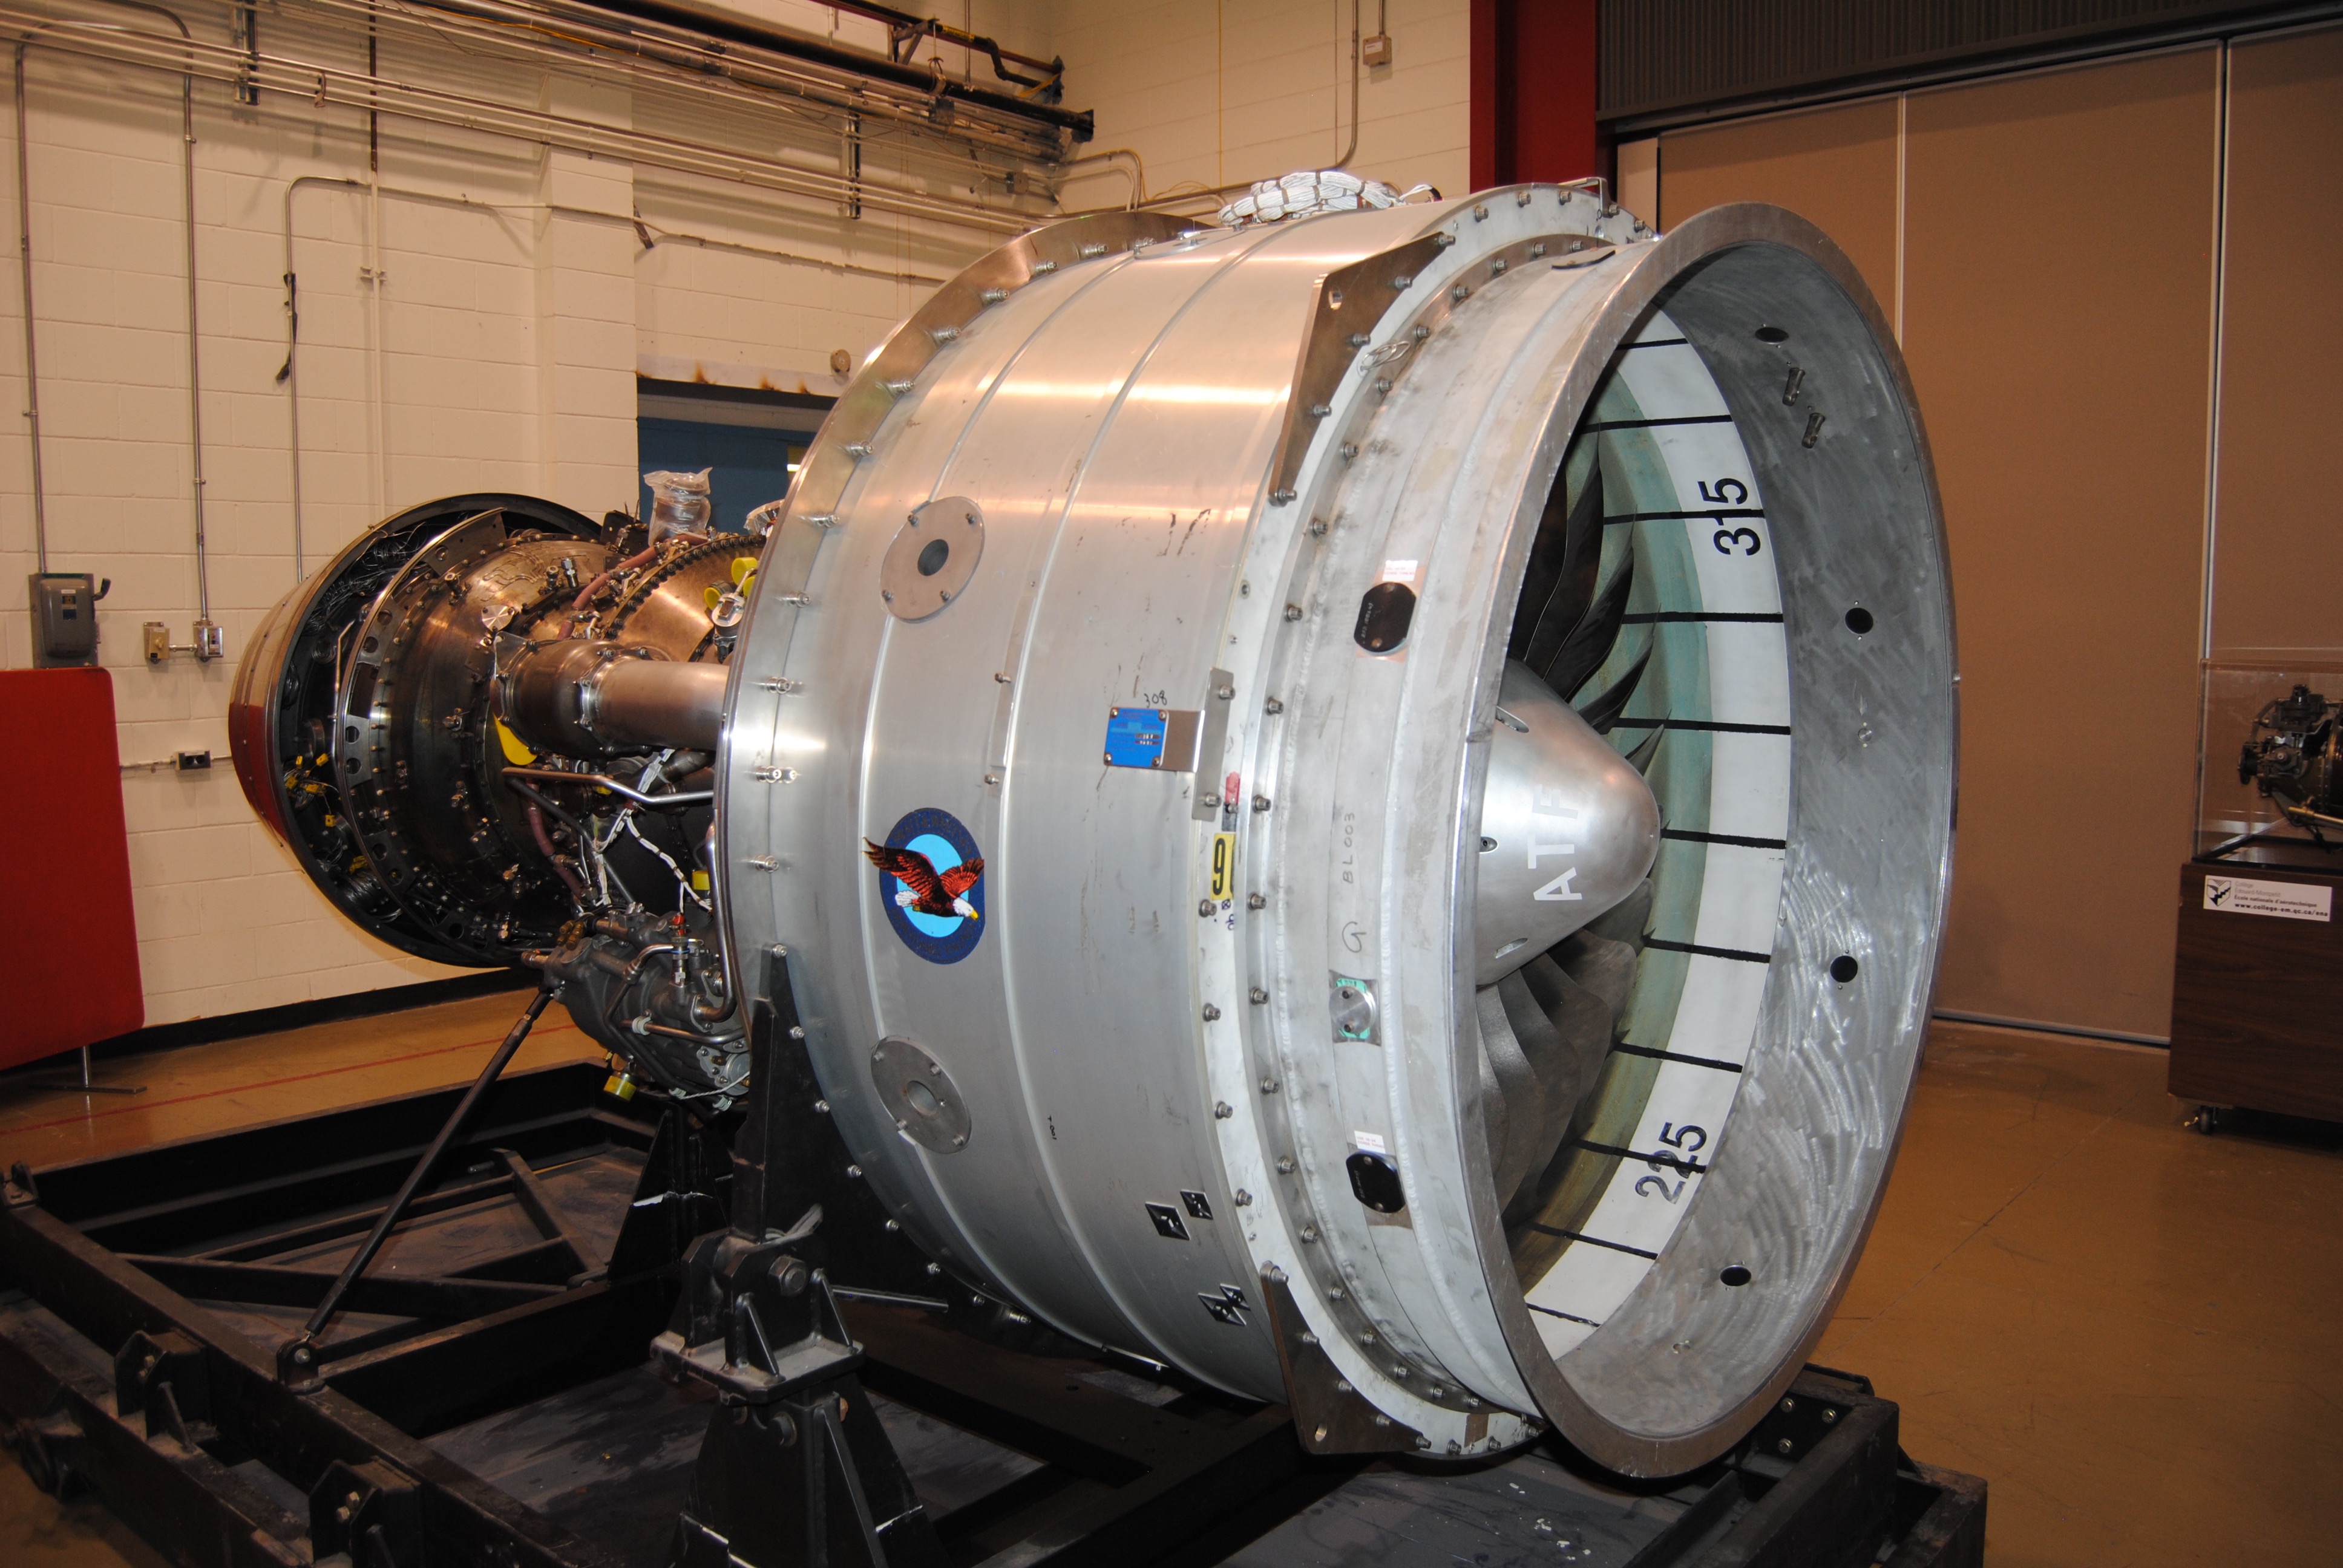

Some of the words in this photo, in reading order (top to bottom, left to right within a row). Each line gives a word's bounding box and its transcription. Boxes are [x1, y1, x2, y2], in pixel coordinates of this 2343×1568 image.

[1144, 690, 1167, 708] 308
[1527, 783, 1582, 901] ATF
[2235, 903, 2328, 916] www.college-em.qc.ca/ena
[1634, 1122, 1707, 1204] 225
